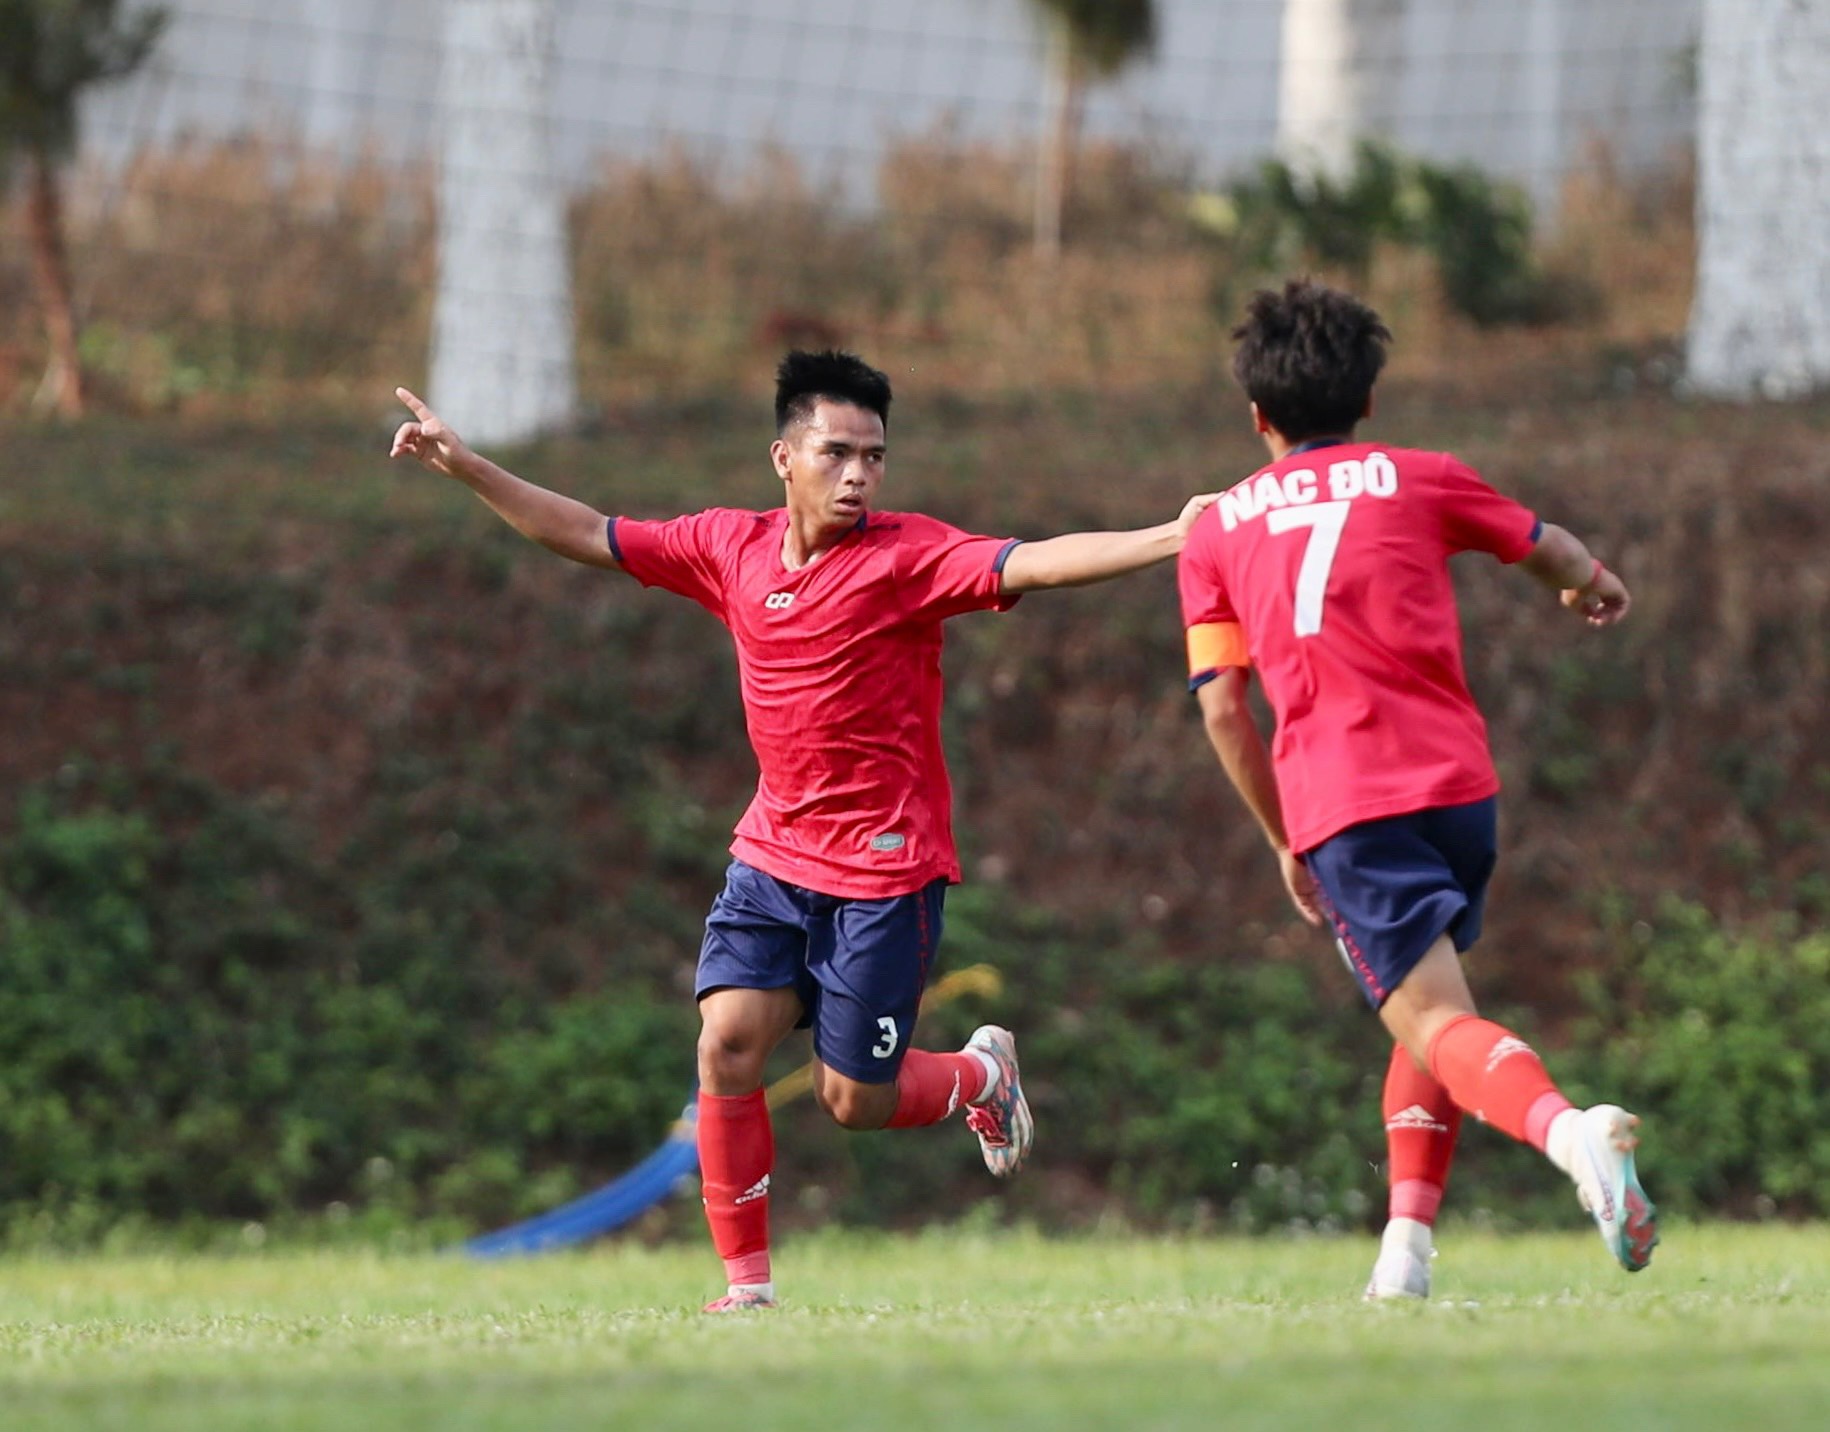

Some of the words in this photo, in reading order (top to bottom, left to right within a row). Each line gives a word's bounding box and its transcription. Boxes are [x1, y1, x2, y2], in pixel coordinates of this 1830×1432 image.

[1217, 468, 1318, 532] NÁC
[1327, 451, 1398, 500] ĐÔ
[1266, 500, 1351, 637] 7
[872, 1016, 898, 1058] 3
